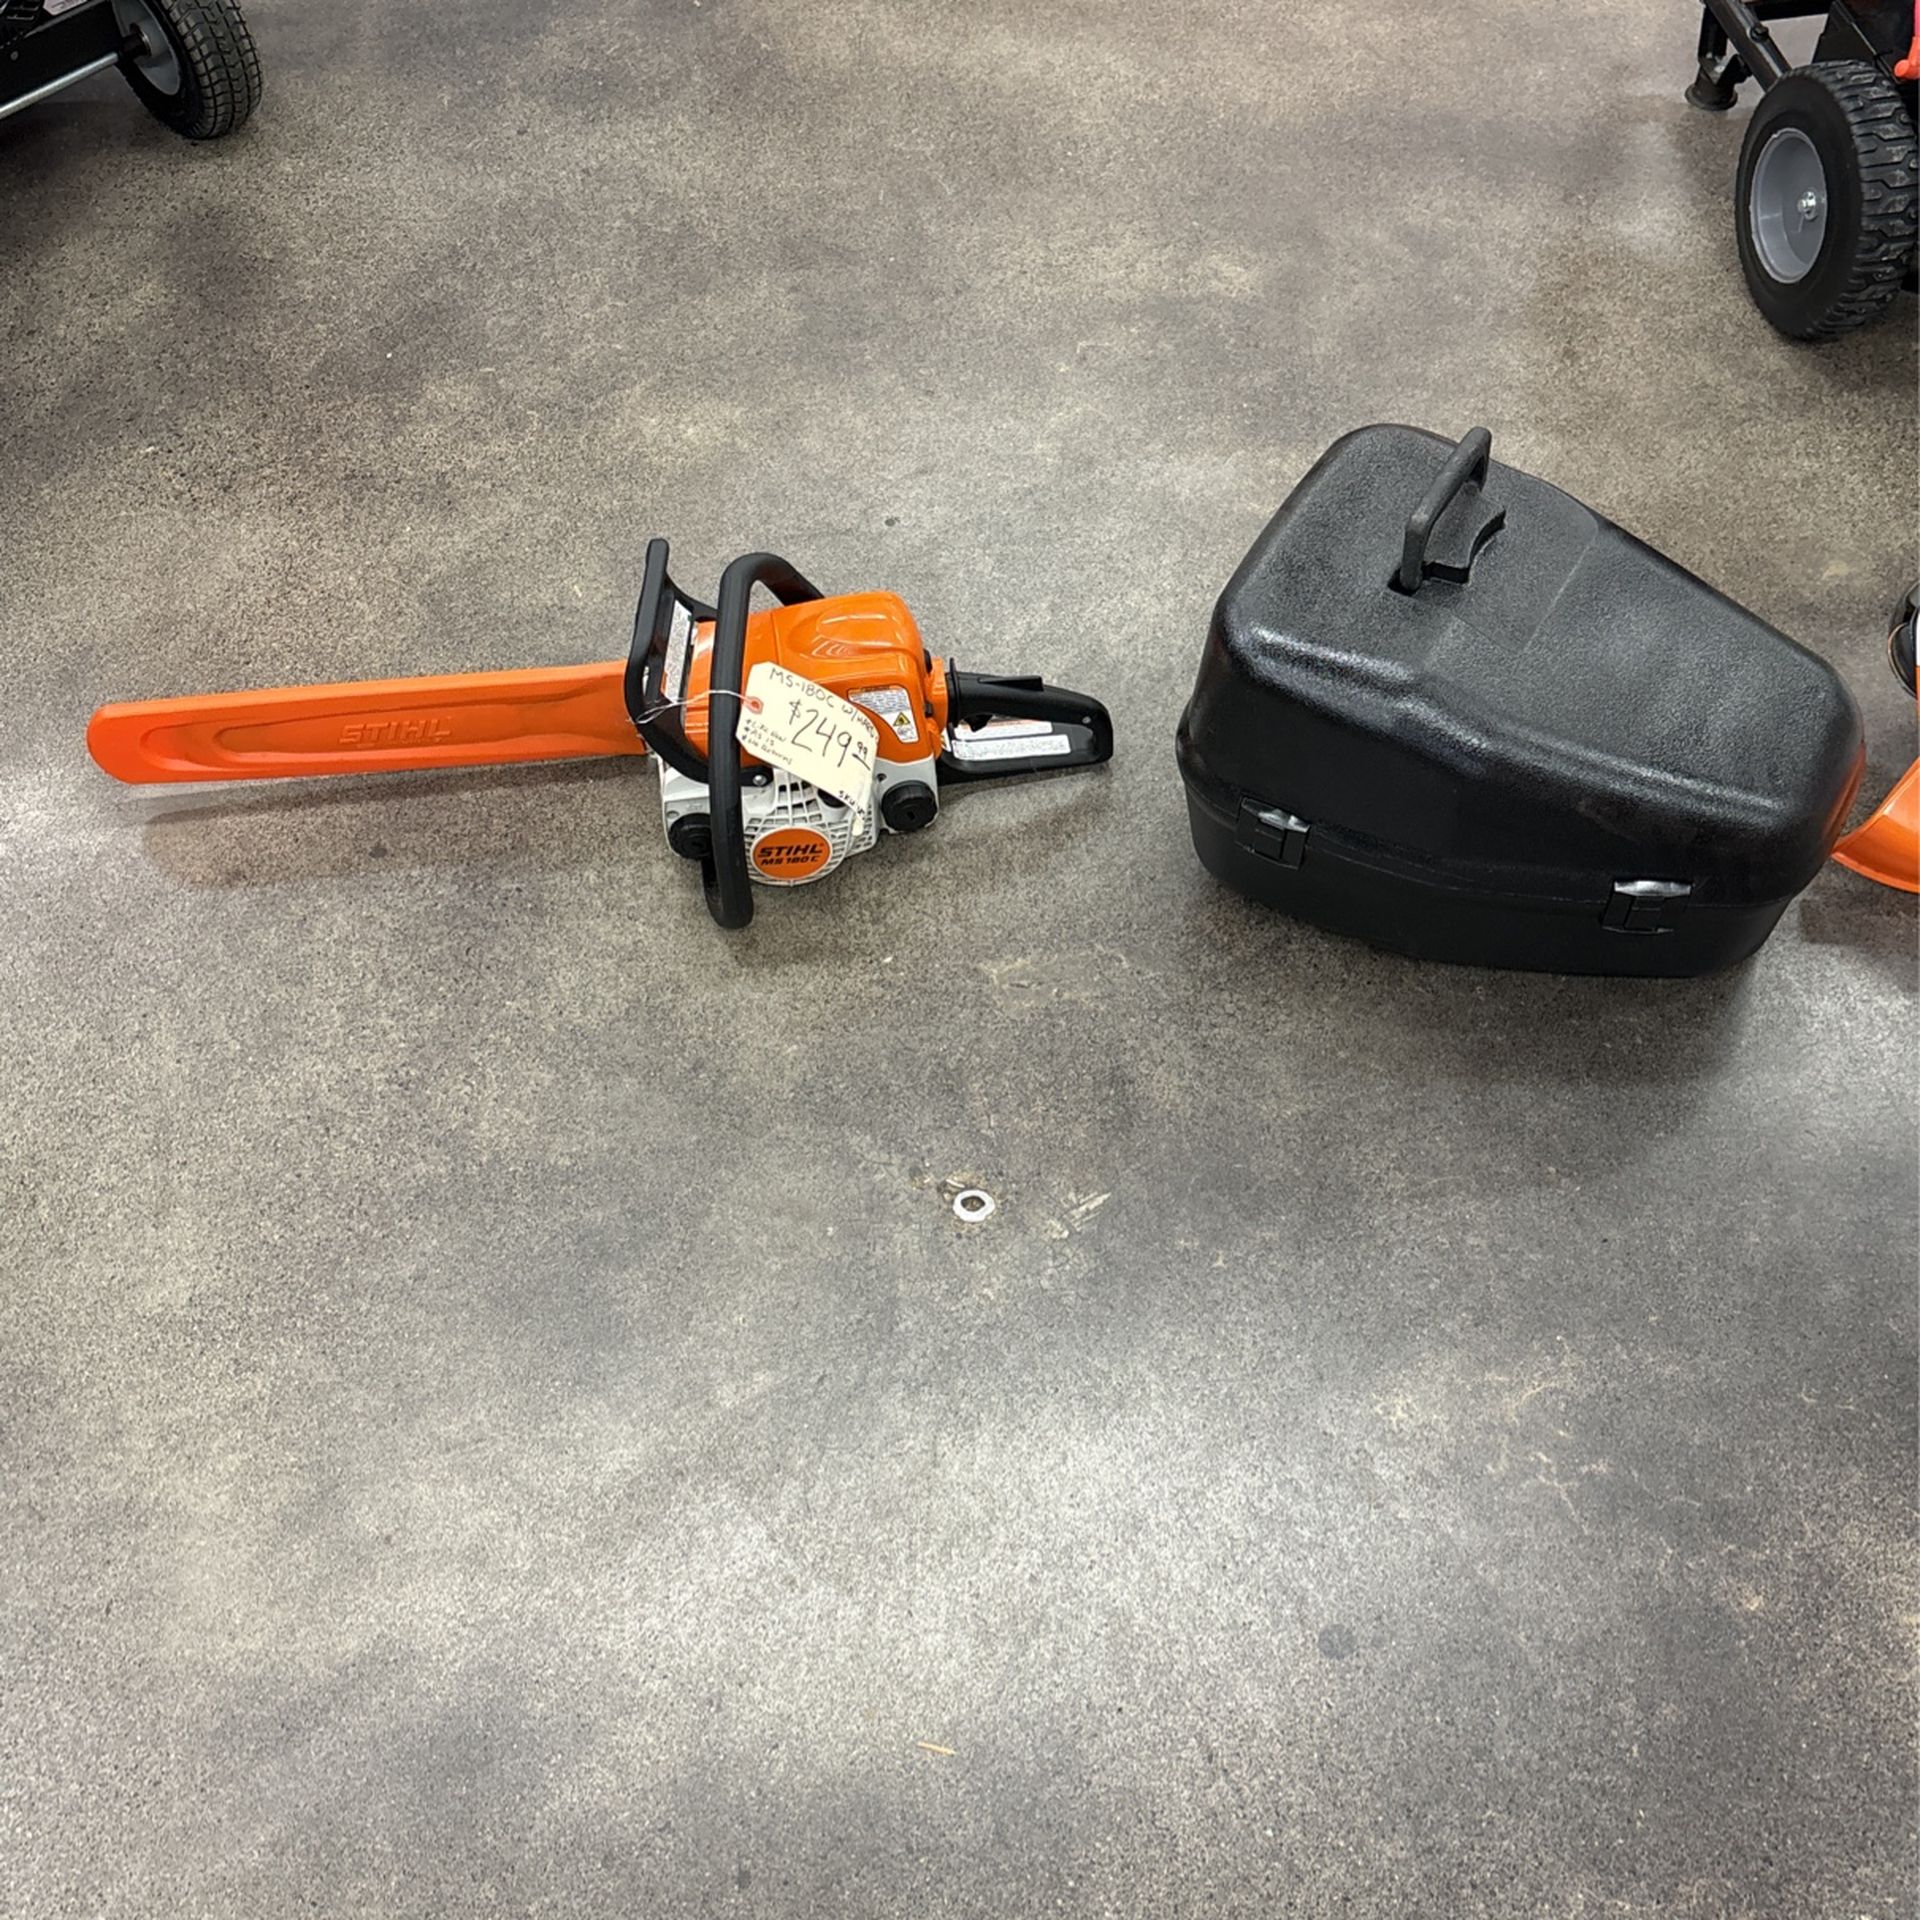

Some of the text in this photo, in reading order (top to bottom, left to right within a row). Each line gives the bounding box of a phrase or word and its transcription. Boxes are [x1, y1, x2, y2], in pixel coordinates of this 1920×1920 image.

[769, 668, 834, 708] MS-180C
[339, 719, 451, 744] STIHL
[758, 844, 823, 858] STIHL
